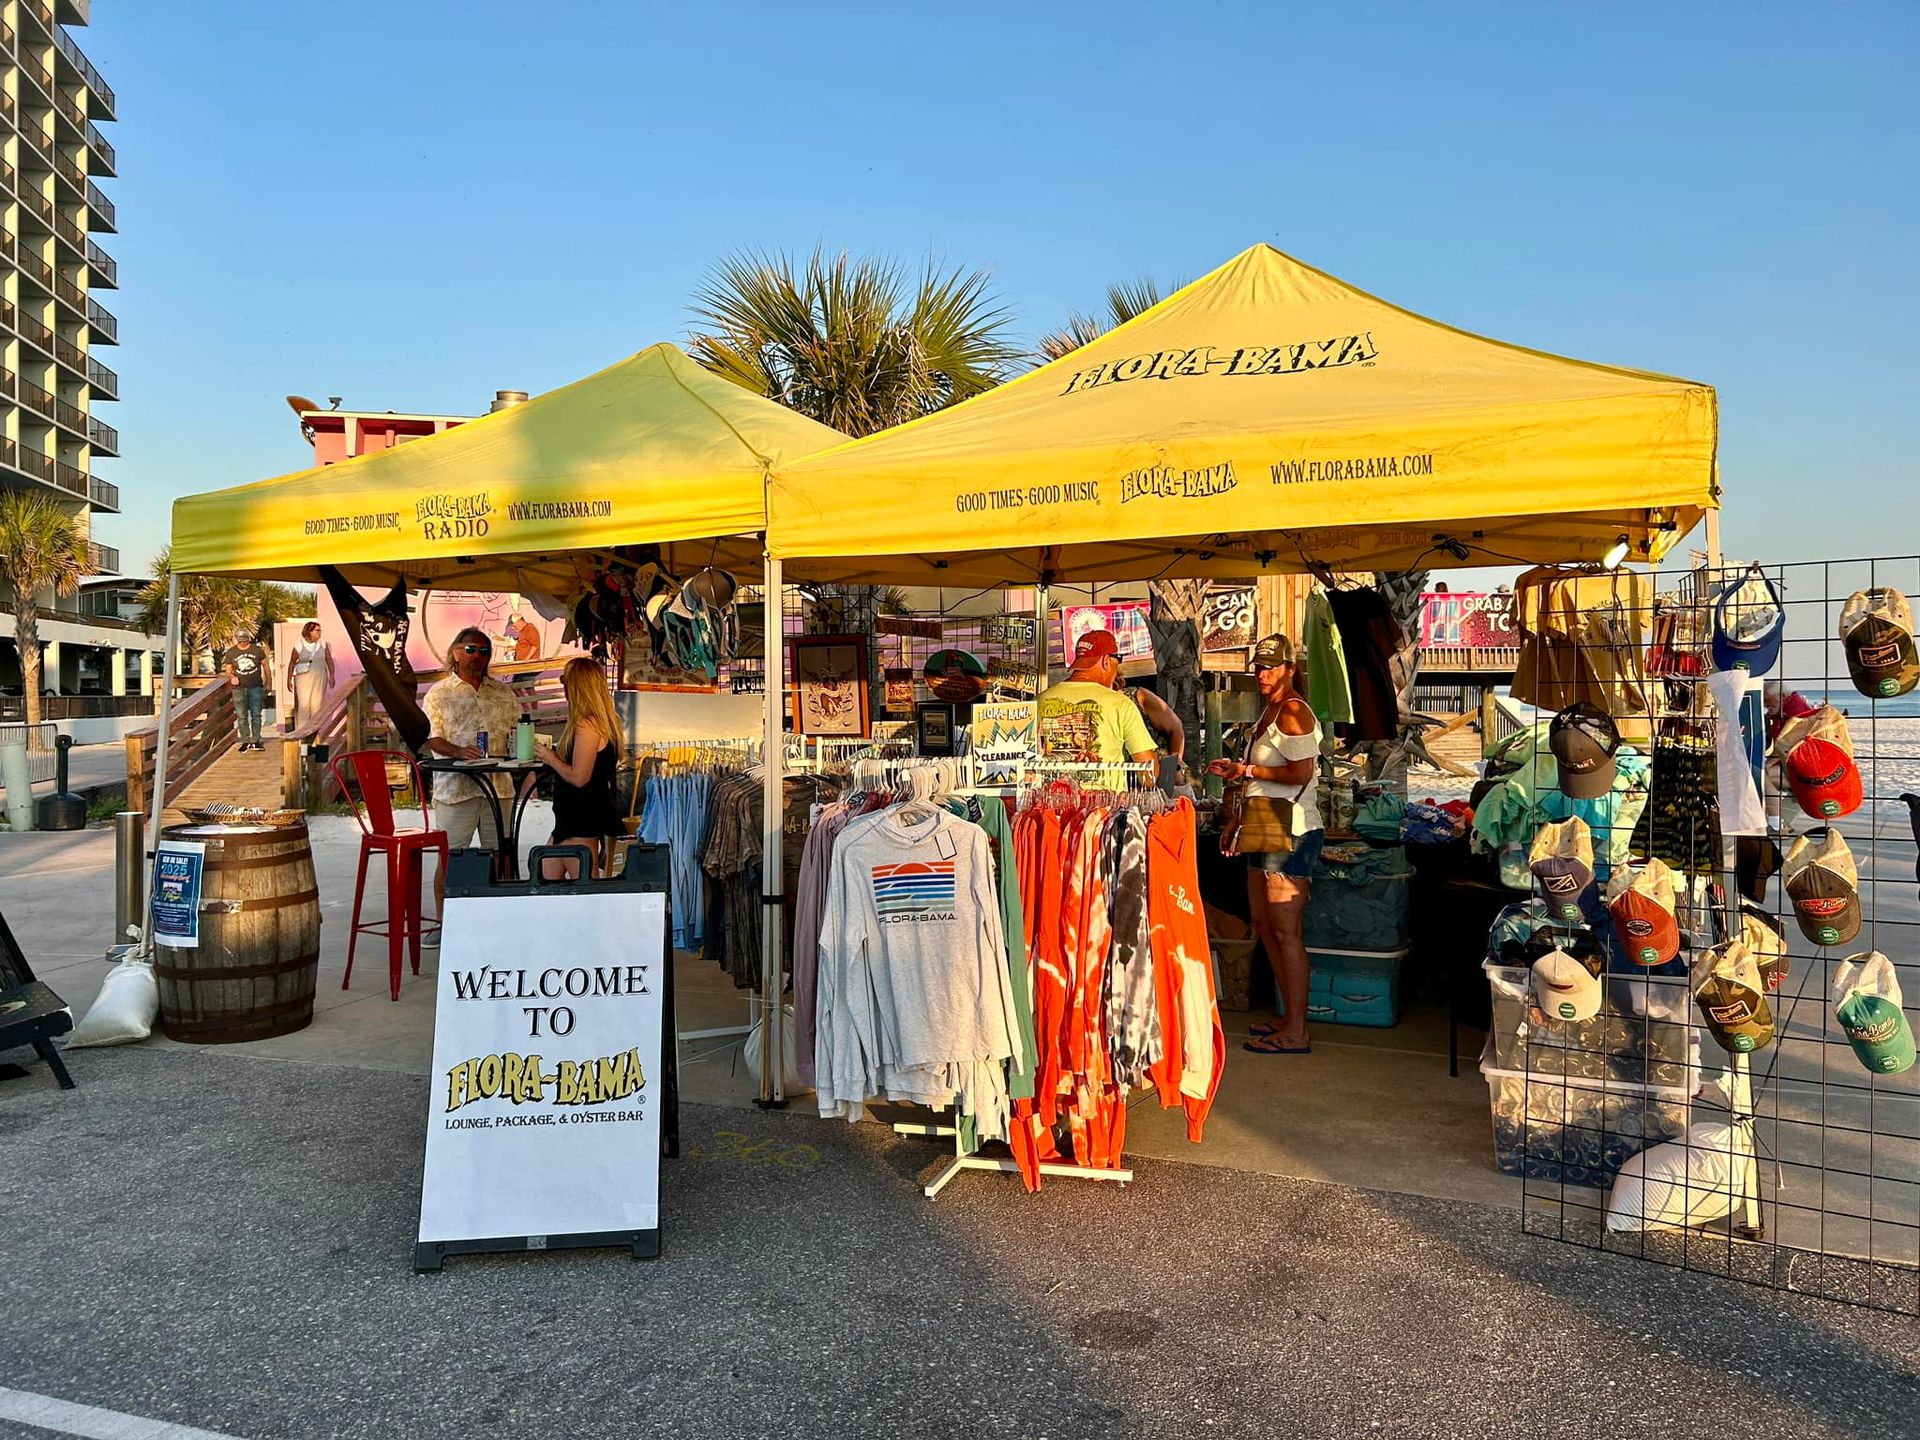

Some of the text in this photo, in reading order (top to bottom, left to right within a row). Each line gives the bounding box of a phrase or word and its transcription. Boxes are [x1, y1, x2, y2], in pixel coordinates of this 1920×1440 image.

[1059, 331, 1379, 397] FLORA-BAMA
[1270, 454, 1433, 485] WWW.FLORABAMA.COM
[1121, 460, 1238, 504] FLORA-BAMA
[415, 491, 492, 522] FLORA-BAMA
[956, 492, 987, 513] GOOD
[1063, 481, 1099, 503] MUSIC
[507, 501, 612, 521] WWW.FLORABAMA.COM
[305, 519, 326, 535] GOOD
[376, 512, 400, 529] MUSIC
[424, 518, 489, 540] RADIO
[1216, 592, 1252, 610] CAN
[1462, 597, 1503, 611] GRAB
[1217, 608, 1254, 631] GO
[981, 751, 1027, 762] CLEARANCE
[162, 863, 188, 876] 2025
[451, 964, 651, 1001] WELCOME
[523, 1006, 577, 1038] TO
[445, 1046, 646, 1113] FLORA-BAMA
[445, 1110, 644, 1130] LOUNGE, PACKAGE, & OYSTER BAR
